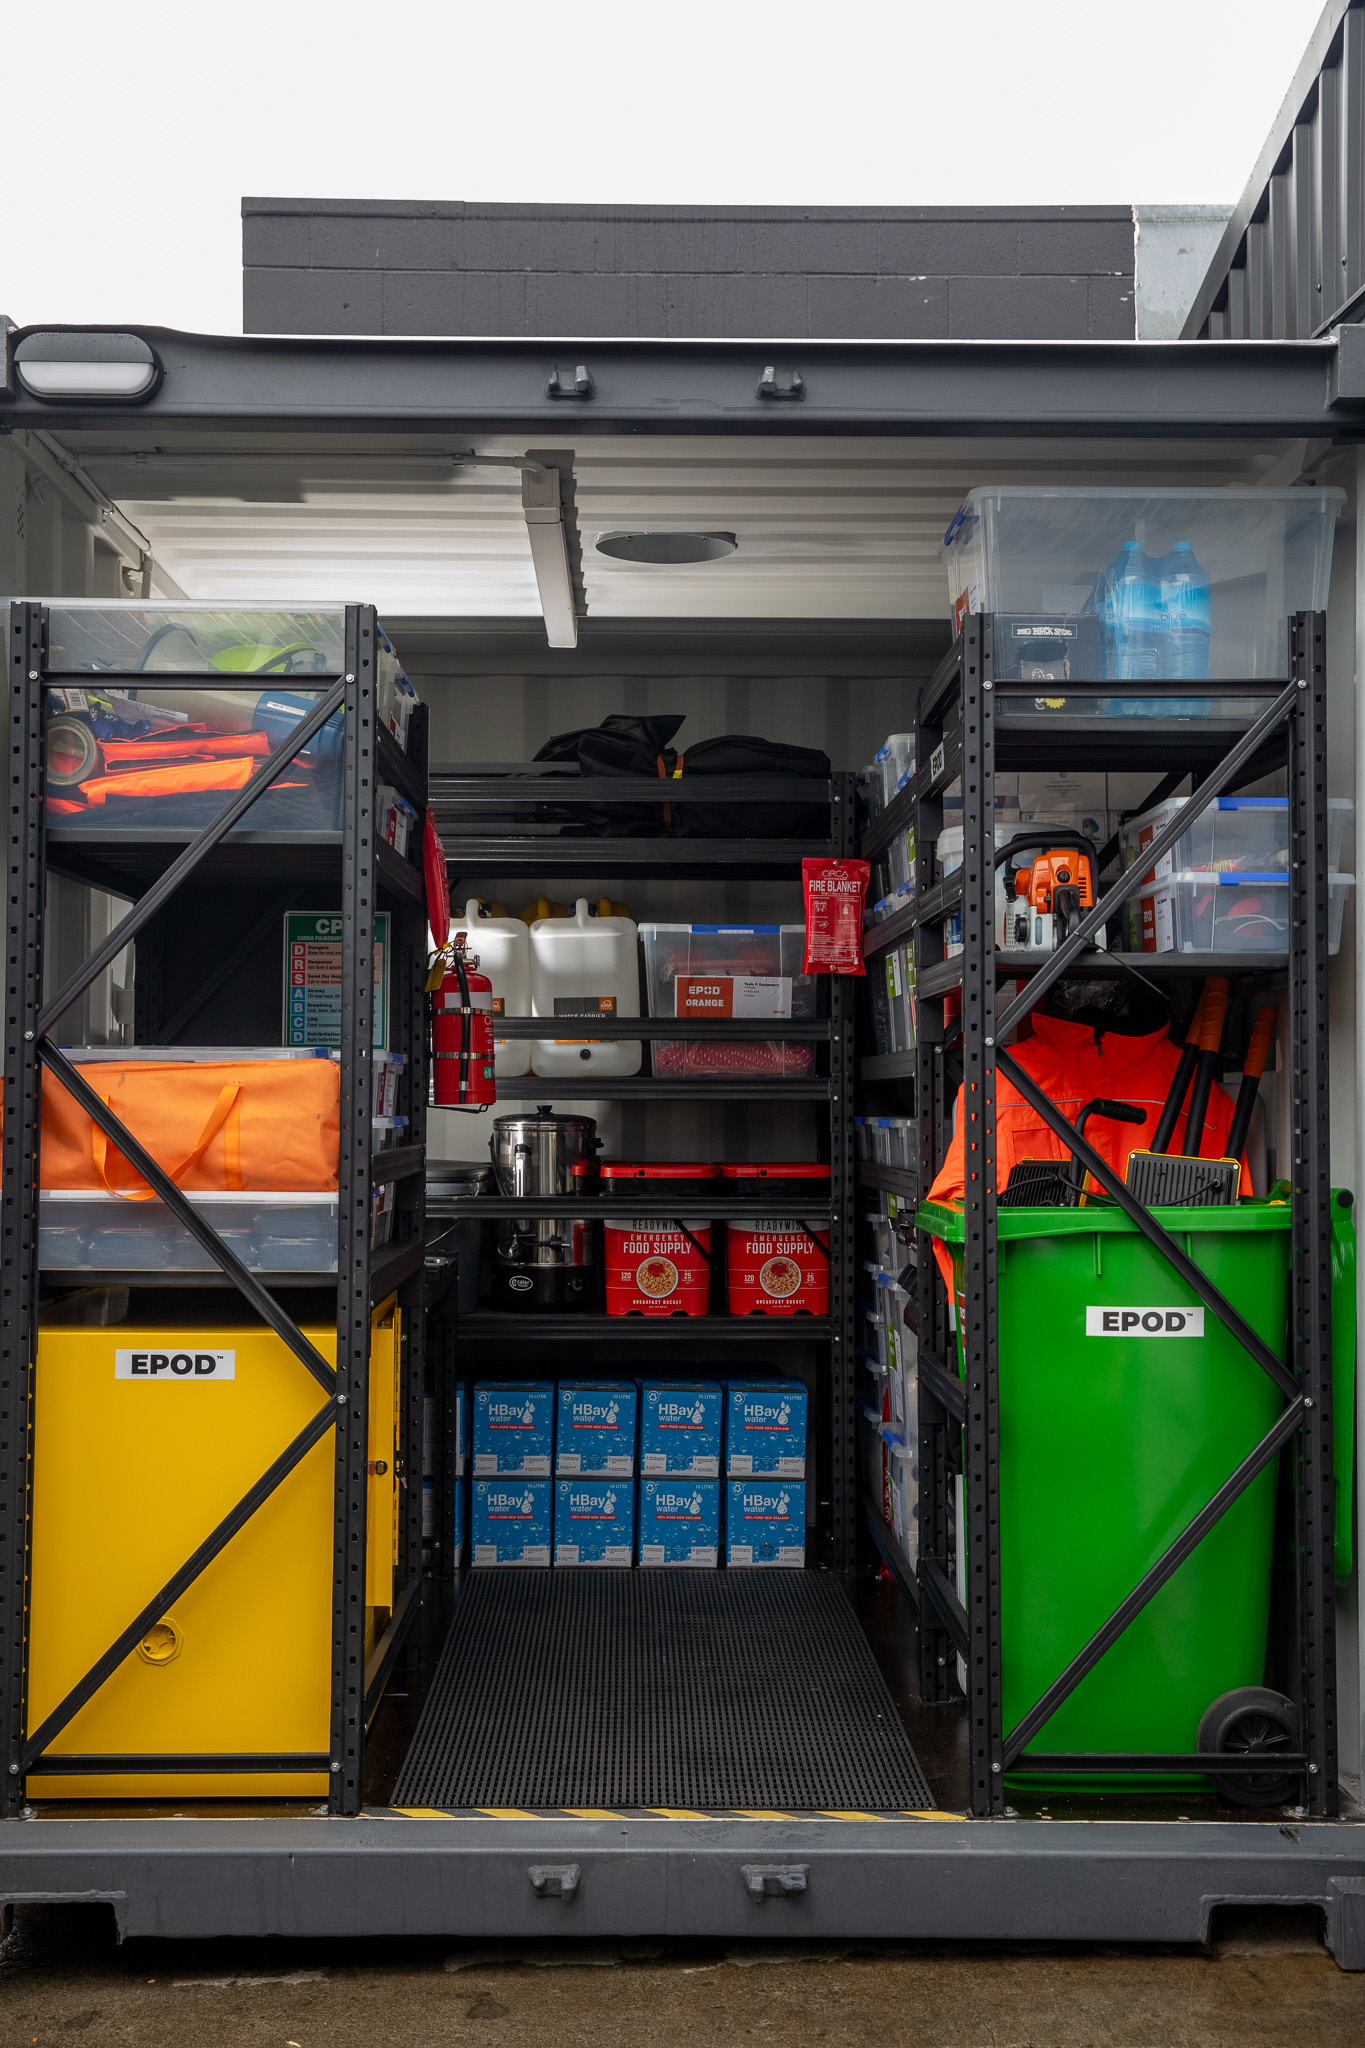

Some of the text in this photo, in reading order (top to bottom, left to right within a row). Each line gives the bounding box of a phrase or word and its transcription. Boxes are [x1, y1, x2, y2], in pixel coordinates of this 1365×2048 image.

[1016, 628, 1032, 636] BIG
[821, 869, 849, 878] ORCA
[809, 880, 862, 893] FIRE BLANKET
[315, 919, 343, 935] CP
[294, 945, 304, 956] D
[294, 959, 304, 970] R
[294, 973, 304, 985] S
[293, 988, 304, 999] A
[688, 986, 720, 995] EPOD
[293, 1002, 303, 1013] B
[685, 999, 724, 1007] ORANGE
[293, 1016, 304, 1028] C
[293, 1031, 303, 1042] D
[632, 1220, 679, 1230] READYWIS
[755, 1220, 801, 1231] READYWIS
[630, 1234, 685, 1242] EMERGENCY
[753, 1234, 808, 1242] EMERGENCY
[623, 1242, 692, 1254] FOOD SUPPLY
[746, 1242, 814, 1254] FOOD SUPPLY
[683, 1272, 692, 1280] 25
[744, 1274, 754, 1282] 120
[489, 1404, 524, 1418] HBay
[573, 1403, 608, 1418] HBay
[658, 1403, 694, 1418] HBay
[744, 1404, 779, 1419] HBay
[488, 1494, 523, 1508] HBay
[570, 1494, 605, 1508] HBay
[656, 1494, 691, 1508] HBay
[743, 1494, 779, 1509] HBay
